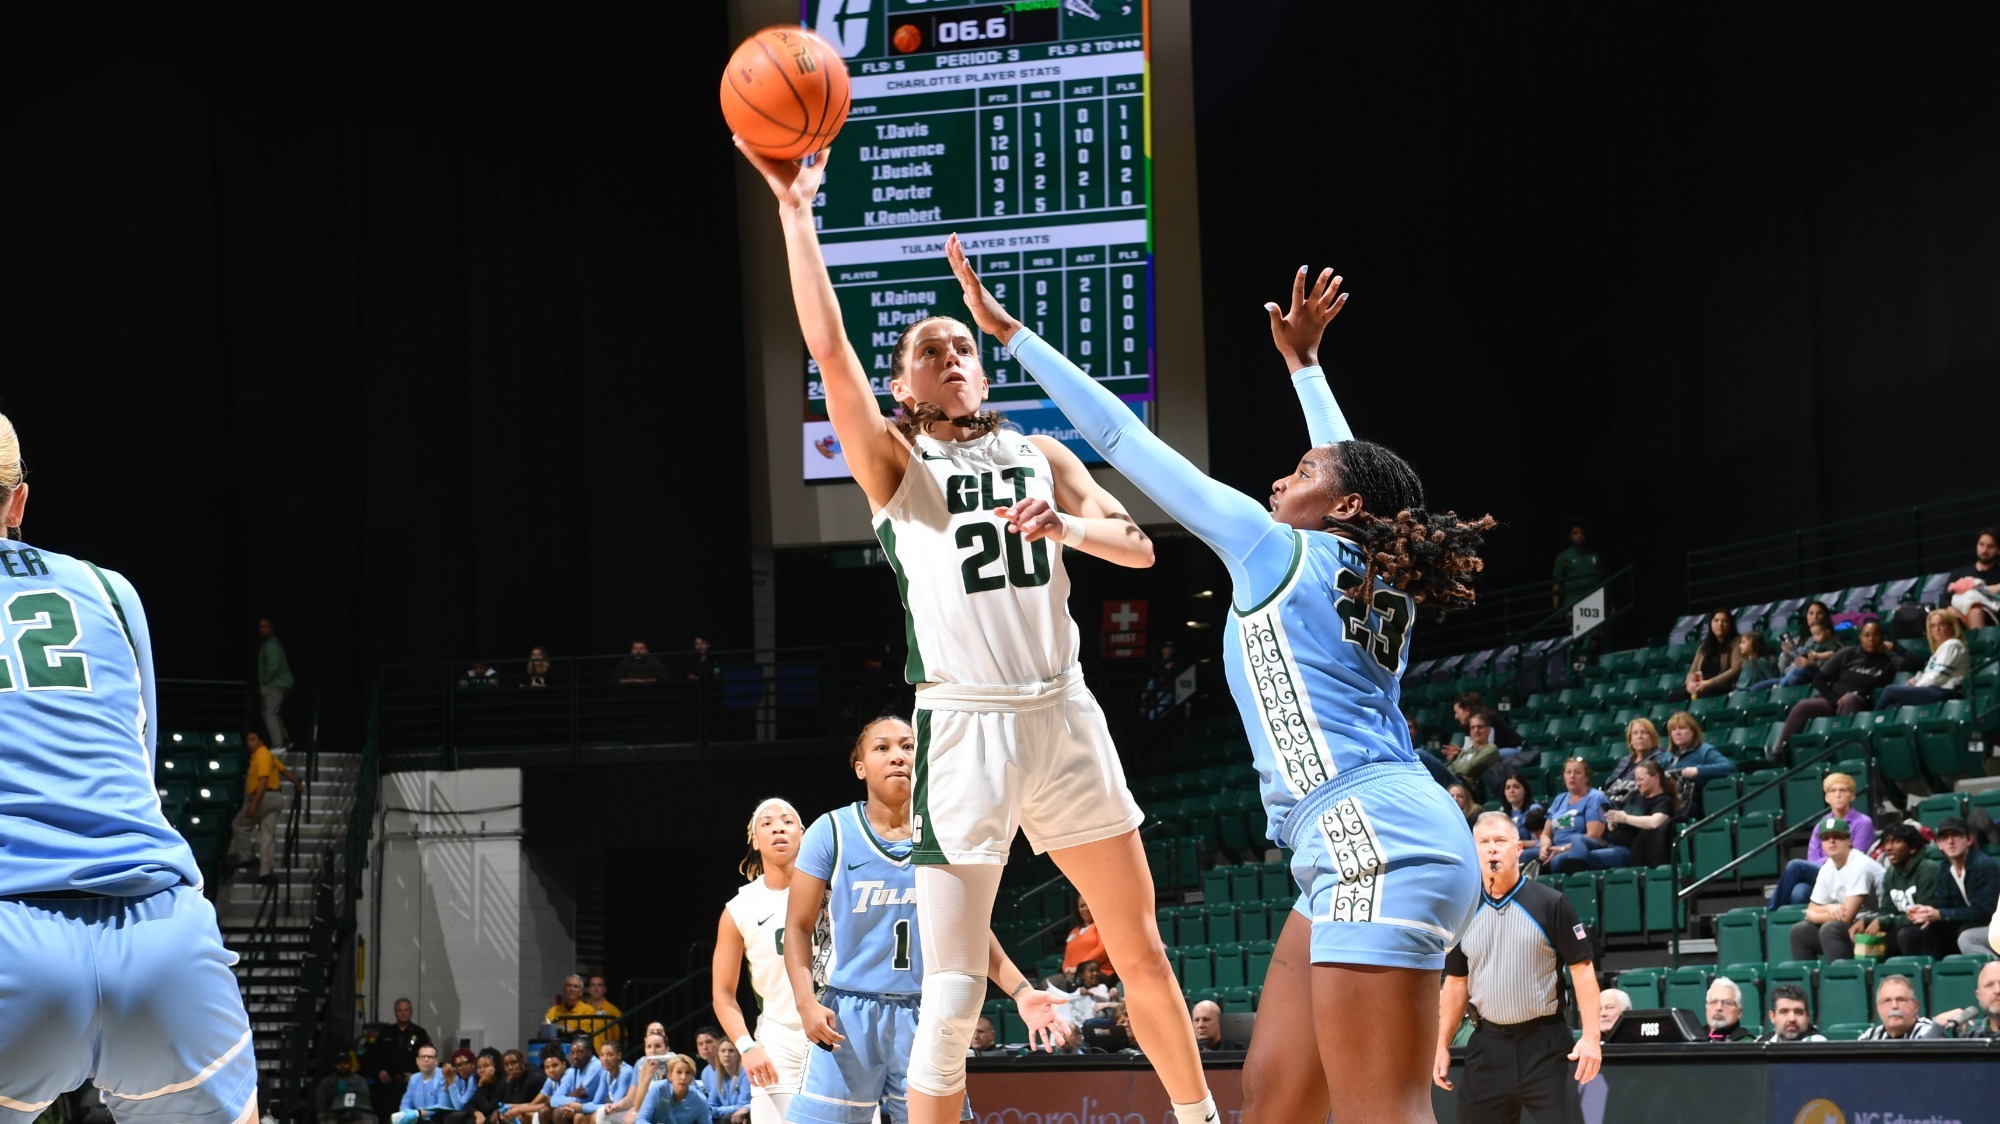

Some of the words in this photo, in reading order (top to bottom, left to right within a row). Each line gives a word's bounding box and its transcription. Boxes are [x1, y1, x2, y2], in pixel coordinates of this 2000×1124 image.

[938, 17, 1007, 43] 06.6
[935, 51, 1002, 68] PERIOD:
[1007, 49, 1020, 62] 3
[1081, 42, 1091, 53] 2
[895, 60, 905, 71] 5
[887, 76, 961, 91] CHARLOTTE
[965, 71, 1016, 84] PLAYER
[1019, 66, 1061, 78] STATS
[988, 94, 1008, 103] PTS
[1073, 86, 1094, 95] AST
[1116, 82, 1136, 91] FLS
[875, 123, 929, 140] T.Davis
[993, 115, 1004, 131] 9
[1034, 112, 1042, 127] 1
[1077, 108, 1089, 123] 0
[1119, 104, 1127, 120] 1
[859, 143, 945, 161] D.Lawrence
[990, 135, 1009, 151] 12
[1034, 132, 1042, 147] 1
[1074, 128, 1094, 144] 10
[1119, 125, 1127, 140] 1
[872, 162, 932, 181] J.Busick
[990, 155, 1010, 171] 10
[1034, 152, 1046, 168] 2
[1077, 148, 1089, 164] 0
[1120, 145, 1132, 160] 0
[872, 185, 933, 203] O.Porter
[993, 178, 1005, 193] 3
[1035, 174, 1046, 190] 2
[1078, 171, 1089, 186] 2
[1120, 167, 1132, 183] 2
[864, 206, 941, 227] K.Rembert
[994, 200, 1005, 216] 2
[1035, 197, 1046, 213] 5
[1078, 194, 1086, 209] 1
[1121, 190, 1132, 206] 0
[901, 244, 947, 255] TULAN
[964, 238, 1005, 250] LAYER
[1009, 234, 1050, 247] STATS
[990, 261, 1010, 270] PTS
[1075, 254, 1096, 263] AST
[1118, 250, 1139, 259] FLS
[840, 271, 878, 281] PLAYER
[871, 290, 936, 307] K.Rainey
[995, 283, 1006, 299] 2
[1036, 280, 1047, 296] 0
[1079, 277, 1091, 292] 2
[1122, 274, 1134, 289] 0
[1036, 301, 1048, 316] 2
[1080, 297, 1091, 313] 0
[1123, 294, 1134, 310] 0
[1037, 321, 1044, 336] 1
[1080, 318, 1091, 333] 0
[1123, 315, 1134, 330] 0
[1080, 340, 1092, 356] 0
[1123, 337, 1135, 353] 0
[996, 369, 1007, 384] 5
[1123, 360, 1131, 375] 1
[947, 467, 1035, 515] CLT
[955, 521, 1051, 595] 20
[1334, 567, 1411, 676] 23
[1579, 607, 1599, 618] 103
[0, 589, 93, 692] 2
[852, 881, 917, 913] TULA
[892, 919, 912, 971] 1
[1641, 1022, 1660, 1036] POSS
